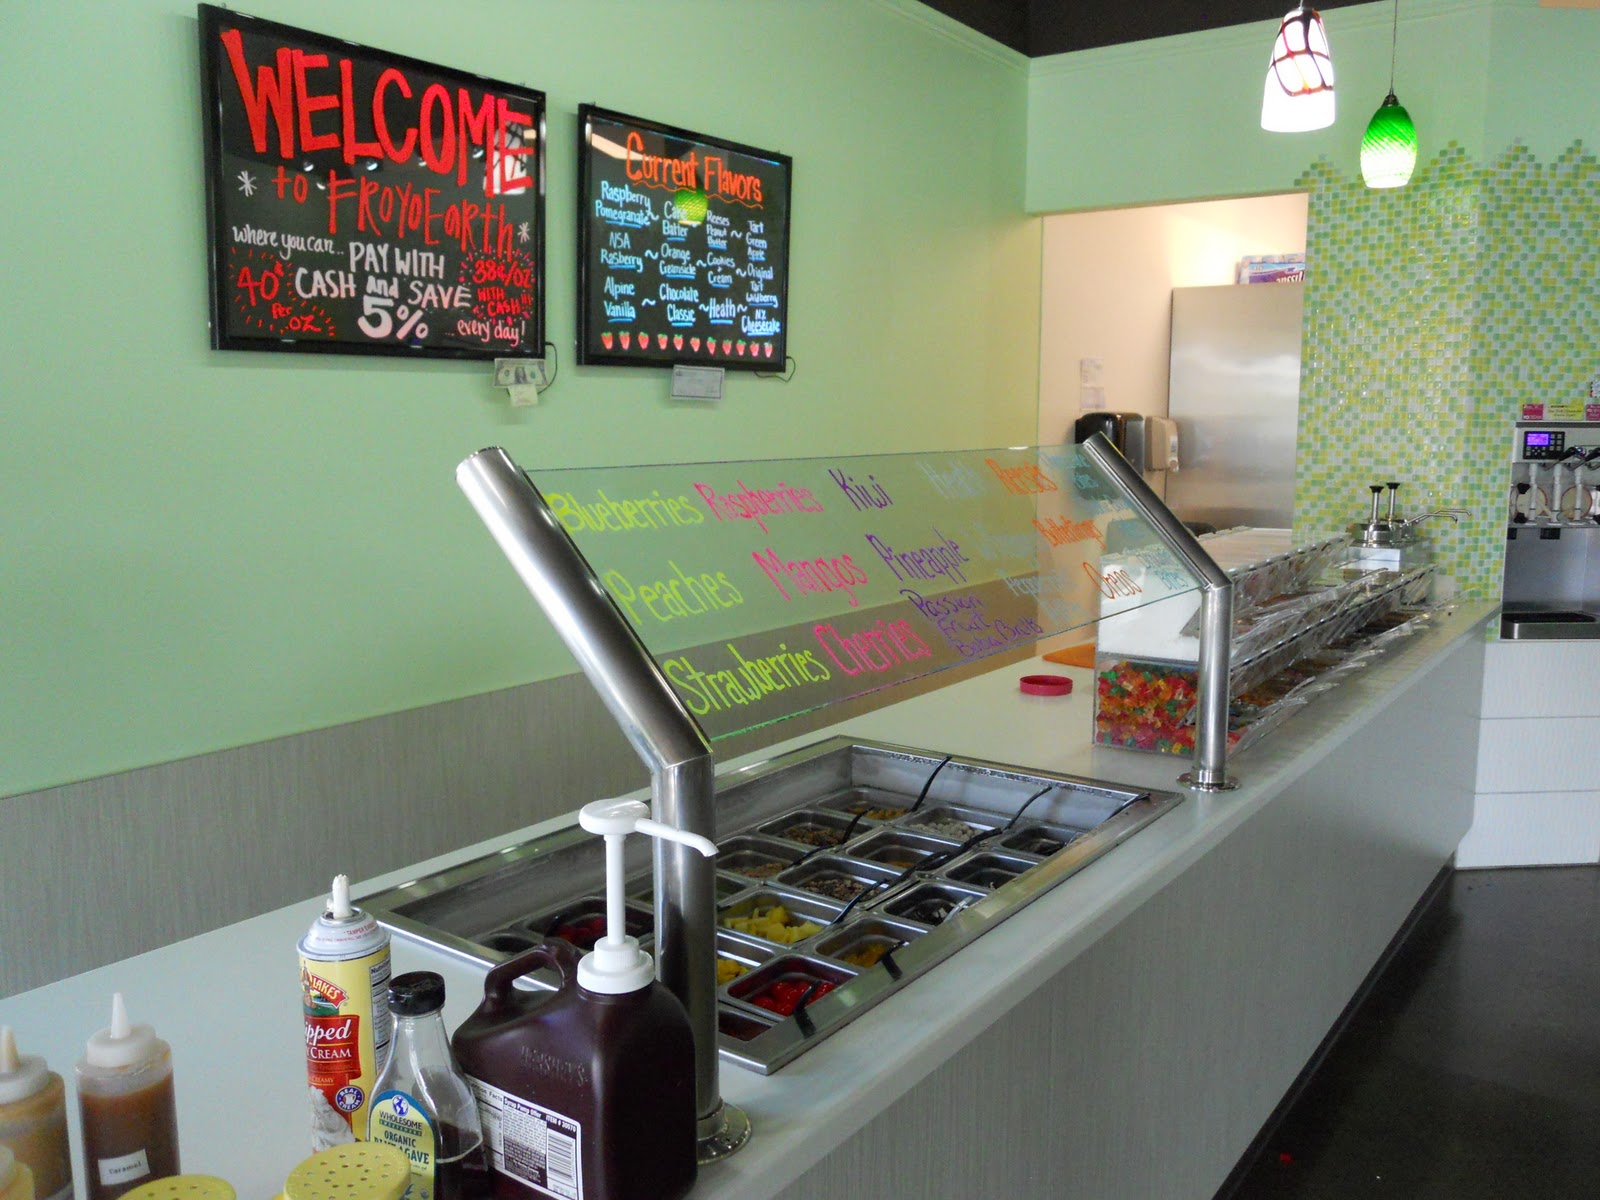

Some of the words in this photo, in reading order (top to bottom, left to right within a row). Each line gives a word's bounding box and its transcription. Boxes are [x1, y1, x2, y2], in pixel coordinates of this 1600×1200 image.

[219, 28, 535, 199] WELCOME
[626, 131, 698, 188] Current
[704, 155, 762, 203] Flavors
[272, 165, 308, 203] to
[601, 180, 652, 212] Raspberry
[595, 199, 651, 227] Pomegranate
[662, 219, 688, 237] Batter
[232, 223, 278, 248] where
[279, 234, 306, 261] you
[609, 231, 631, 249] NSA
[348, 241, 389, 273] PAY
[394, 247, 445, 279] WITH
[600, 248, 643, 273] Rasberry
[660, 242, 691, 265] Orange
[707, 251, 735, 268] Cookies
[659, 260, 696, 276] Creamsicle
[708, 270, 733, 285] Cream
[747, 262, 774, 281] Original
[295, 267, 356, 299] CASH
[407, 280, 472, 309] SAVE
[477, 286, 505, 302] WITH
[604, 276, 636, 300] Alpine
[659, 283, 699, 303] Chocolate
[357, 294, 429, 340] 5%
[604, 301, 636, 319] Vanilla
[667, 303, 696, 322] Classic
[709, 297, 736, 318] Heath
[741, 315, 780, 333] Cheesecake
[828, 468, 894, 512] Kiwi
[543, 489, 705, 535] Blueberries
[693, 480, 824, 534] Raspberries
[864, 527, 970, 584] Pineapple
[752, 547, 868, 608] Mangos
[603, 560, 744, 626] Peaches
[813, 619, 932, 677] Cherries
[663, 643, 831, 715] Strawberries
[313, 977, 341, 1000] LAKES
[310, 1047, 352, 1059] CREAM
[339, 1088, 358, 1096] REAL
[339, 1100, 361, 1110] CREAM
[379, 1110, 423, 1129] WHOLESOME
[384, 1130, 417, 1148] ORGANIC
[399, 1146, 430, 1165] GAVE
